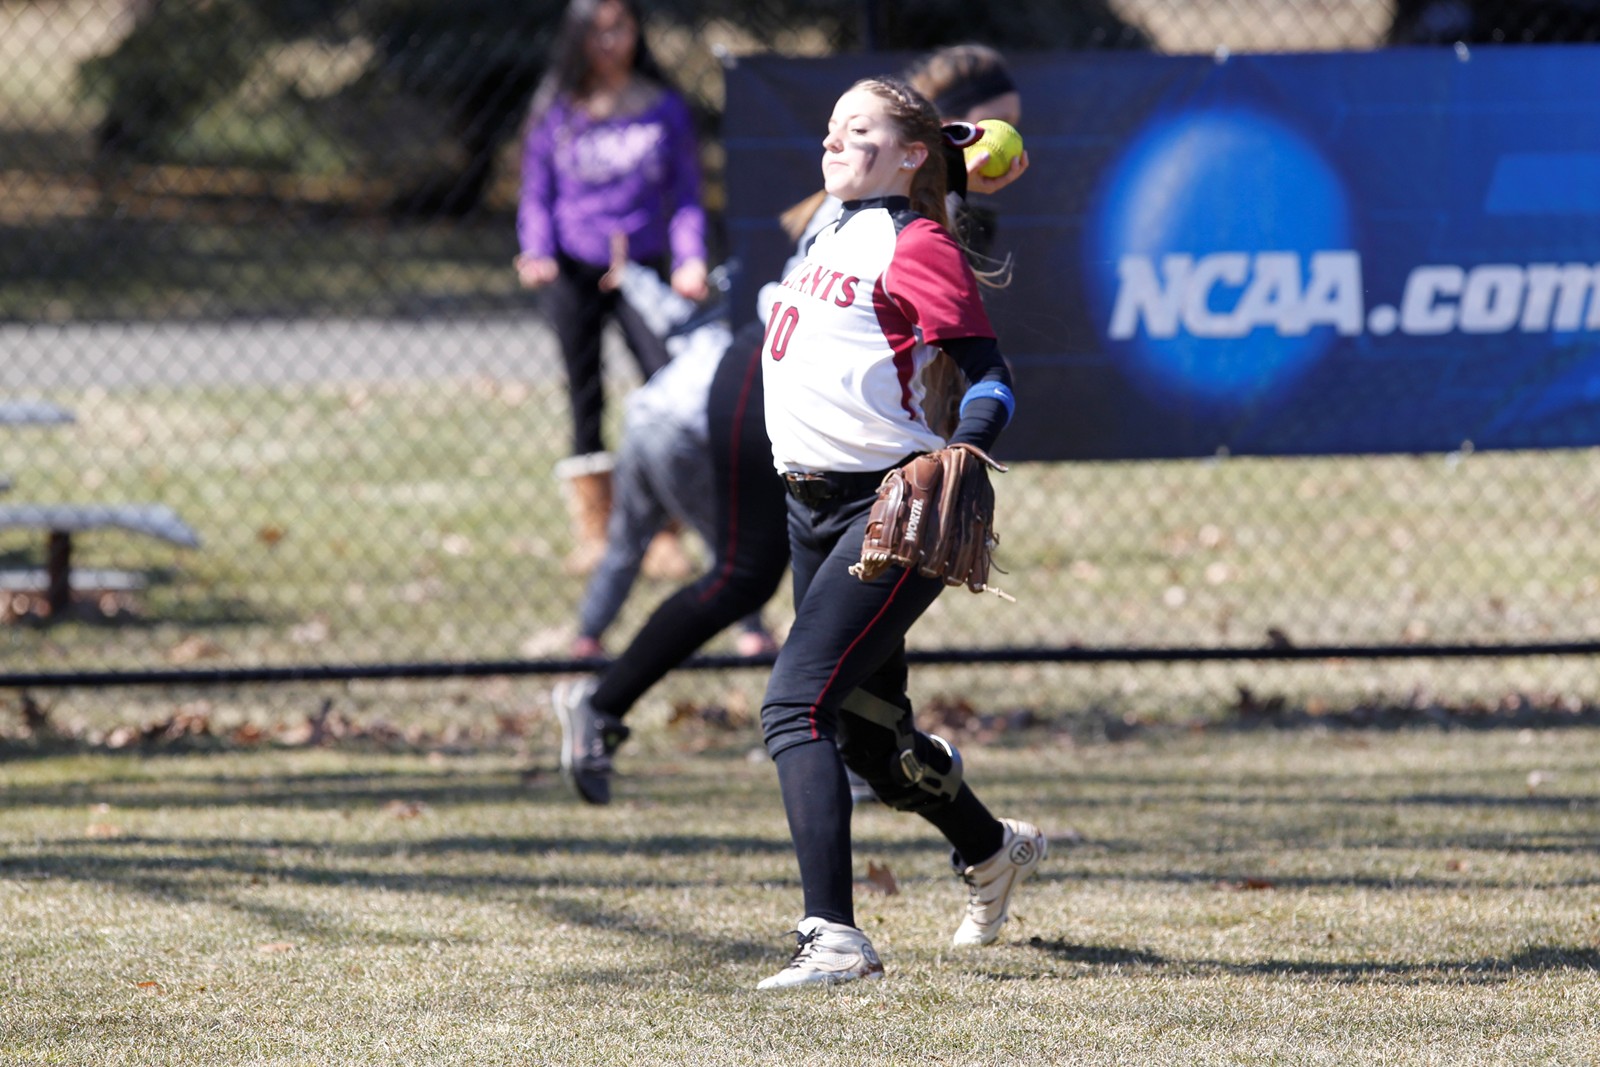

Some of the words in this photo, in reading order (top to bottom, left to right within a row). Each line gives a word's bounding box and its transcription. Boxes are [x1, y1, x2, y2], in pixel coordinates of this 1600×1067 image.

[782, 263, 860, 308] ANTS
[1109, 250, 1600, 339] NCAA.com
[763, 301, 799, 361] 10
[904, 498, 924, 541] WORTH
